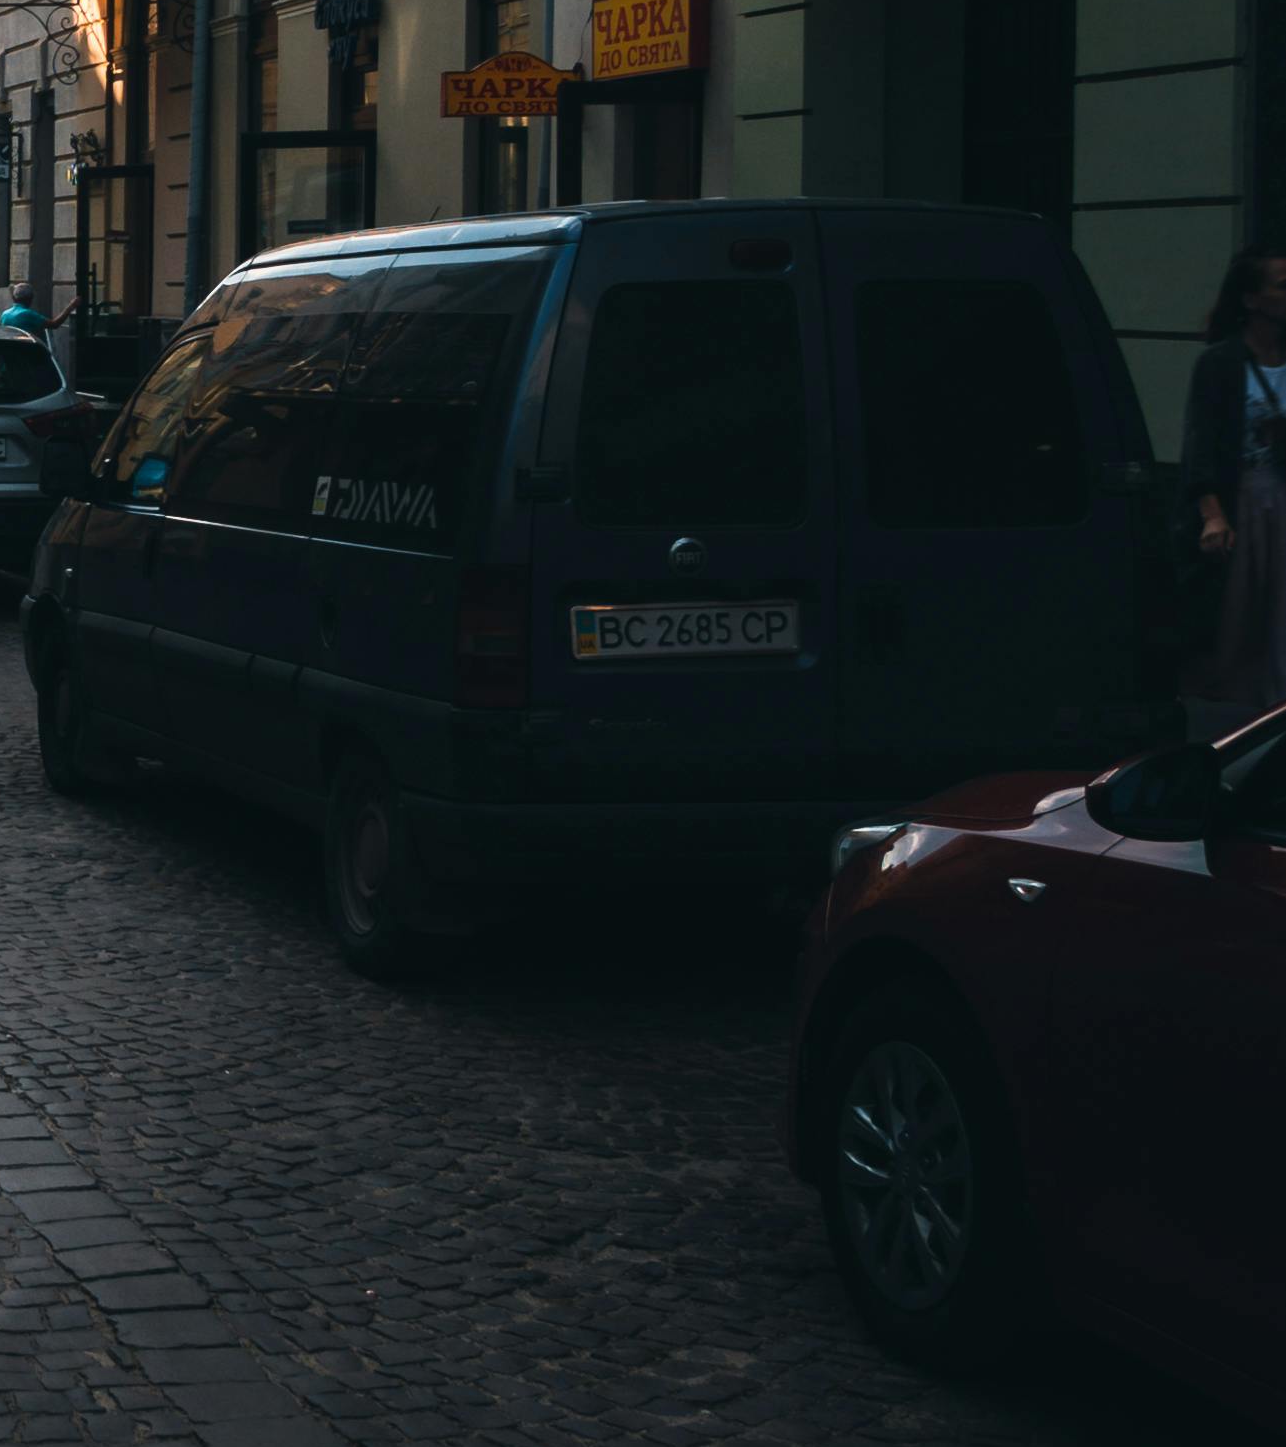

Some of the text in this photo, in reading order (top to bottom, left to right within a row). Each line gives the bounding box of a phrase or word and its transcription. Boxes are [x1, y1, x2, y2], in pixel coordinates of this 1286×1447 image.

[598, 40, 683, 76] ДО СВЯТА
[450, 77, 559, 99] ЧАРК
[454, 100, 558, 115] ДО СВЯТ
[676, 551, 702, 565] FIAT
[599, 610, 789, 649] BC 2685 CP
